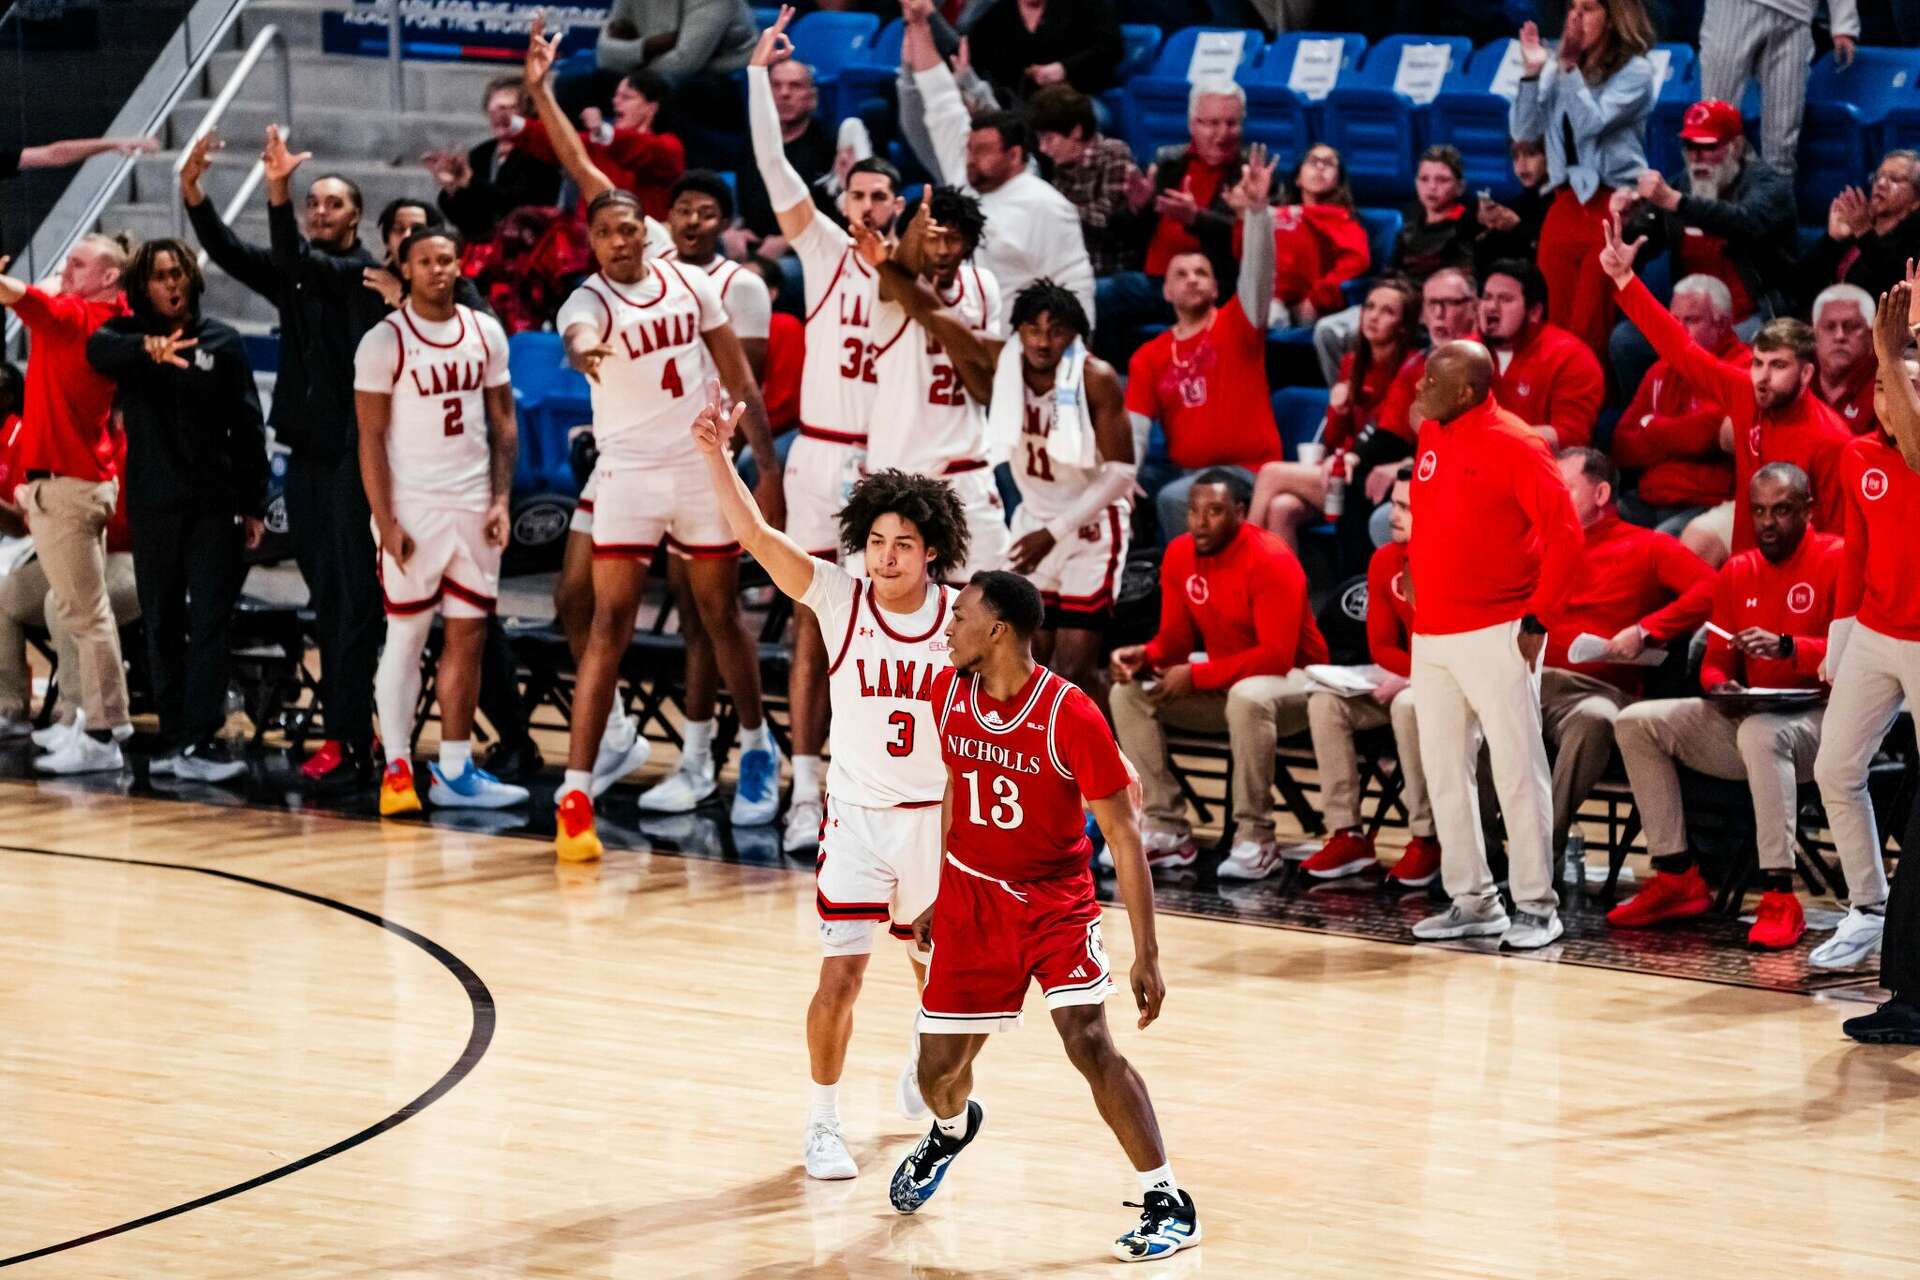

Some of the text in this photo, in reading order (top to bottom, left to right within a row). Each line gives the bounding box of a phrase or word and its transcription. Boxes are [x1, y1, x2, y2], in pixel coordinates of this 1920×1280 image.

[660, 356, 684, 399] 4
[443, 397, 465, 437] 2
[1026, 441, 1055, 483] 11
[856, 658, 932, 702] LAMA
[886, 709, 915, 757] 3
[947, 734, 1040, 775] NICHOLLS
[961, 769, 1024, 830] 13
